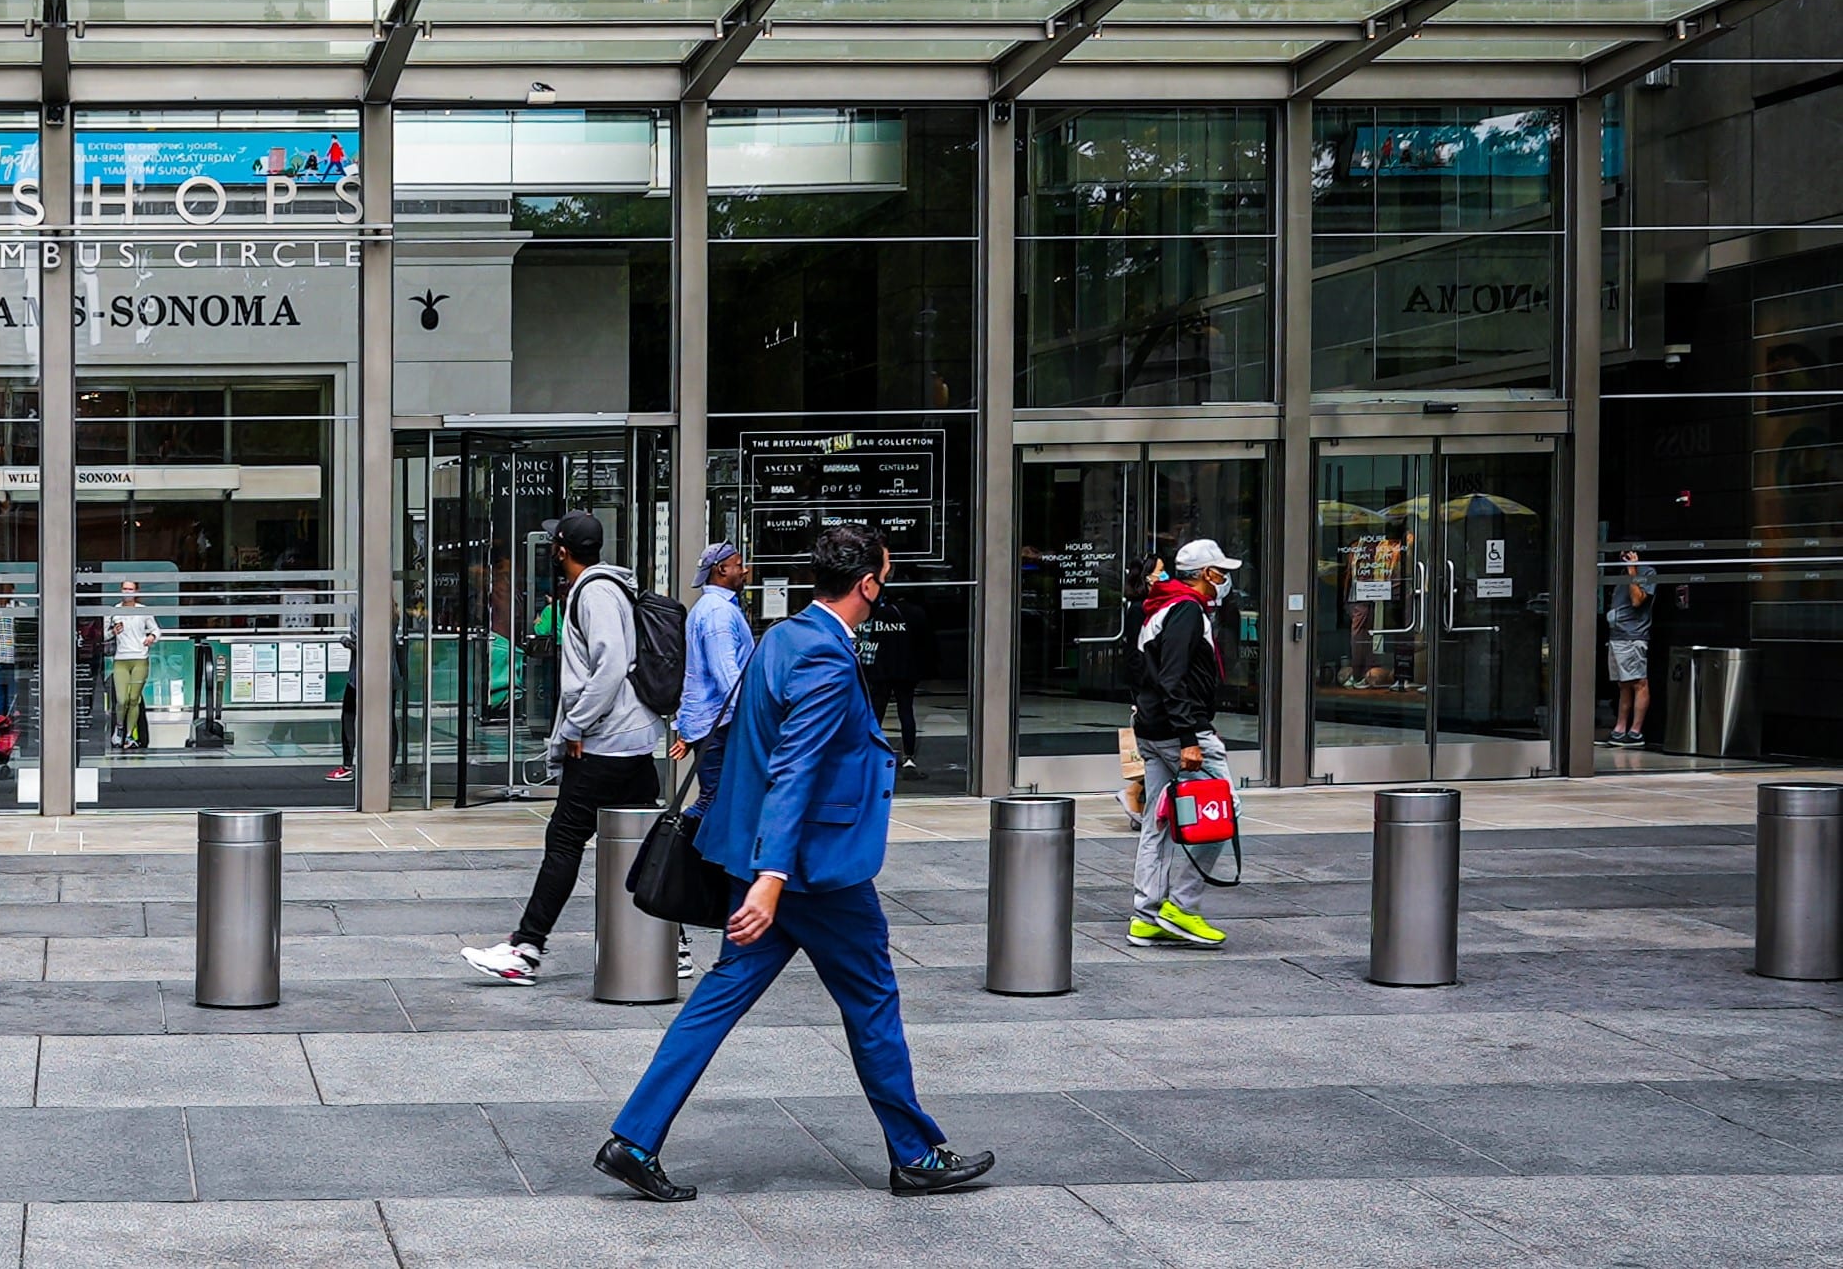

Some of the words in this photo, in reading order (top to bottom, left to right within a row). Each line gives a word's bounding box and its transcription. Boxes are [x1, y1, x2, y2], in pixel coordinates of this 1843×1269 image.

[74, 154, 124, 163] 0AM-8PM
[158, 165, 203, 176] SUNDAY
[15, 175, 364, 227] SHOPS
[174, 241, 363, 268] CIRCLE
[878, 438, 933, 446] COLLECTION
[764, 465, 803, 473] ASCENT
[771, 485, 795, 494] MASA
[821, 484, 843, 494] per
[848, 484, 861, 492] se
[767, 519, 804, 528] BLUEBIRD
[1065, 542, 1093, 551] HOURS
[875, 620, 906, 632] BANK
